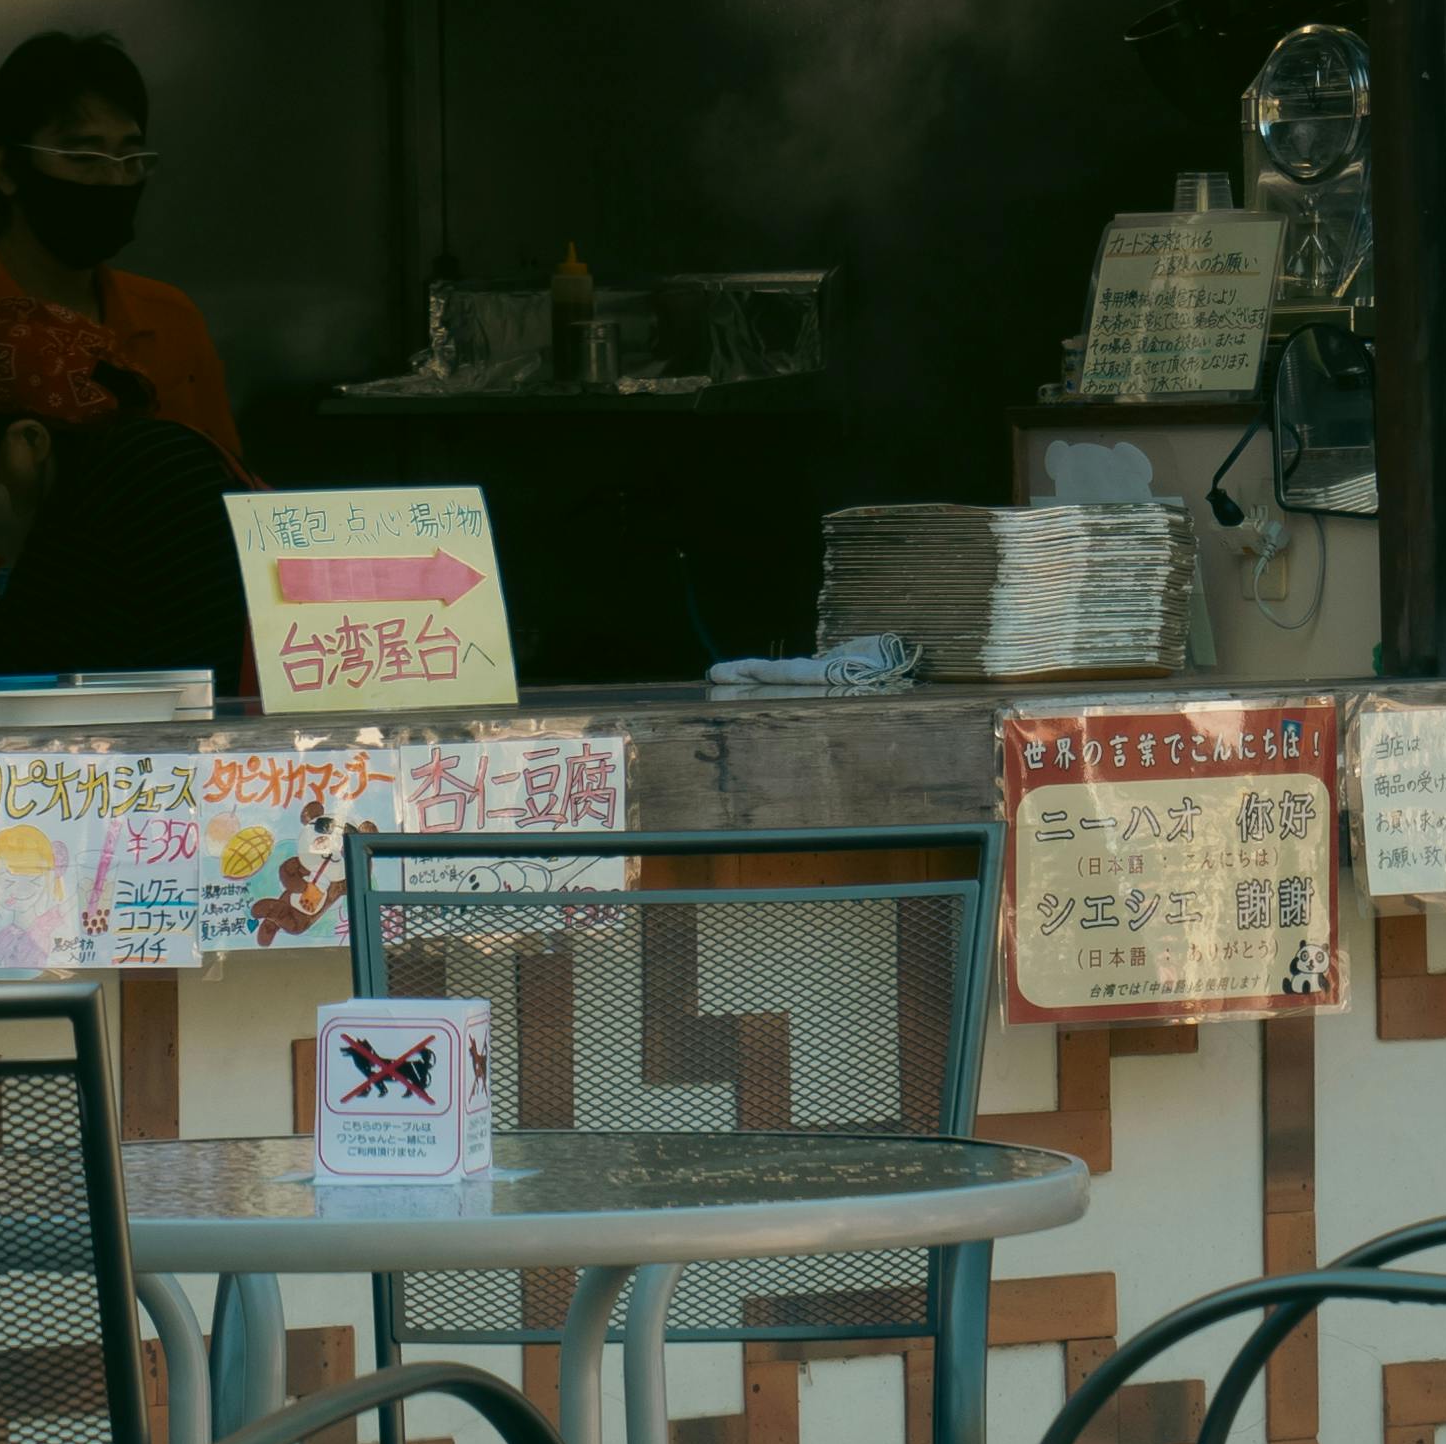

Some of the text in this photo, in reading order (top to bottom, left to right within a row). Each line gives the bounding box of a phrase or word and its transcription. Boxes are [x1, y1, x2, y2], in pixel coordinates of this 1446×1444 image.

[279, 614, 496, 692] 台湾屋台へ
[1023, 728, 1322, 771] 世界の言葉でこんにちは！
[1375, 733, 1421, 760] 当店は
[203, 751, 396, 809] タピオカマンゴー
[407, 743, 617, 833] 杏仁豆腐
[1035, 790, 1316, 842] ニーハオ 你好
[126, 818, 200, 865] ¥350
[116, 879, 199, 906] ミルクティー
[1235, 876, 1316, 930] 謝謝
[116, 937, 167, 963] ライチ
